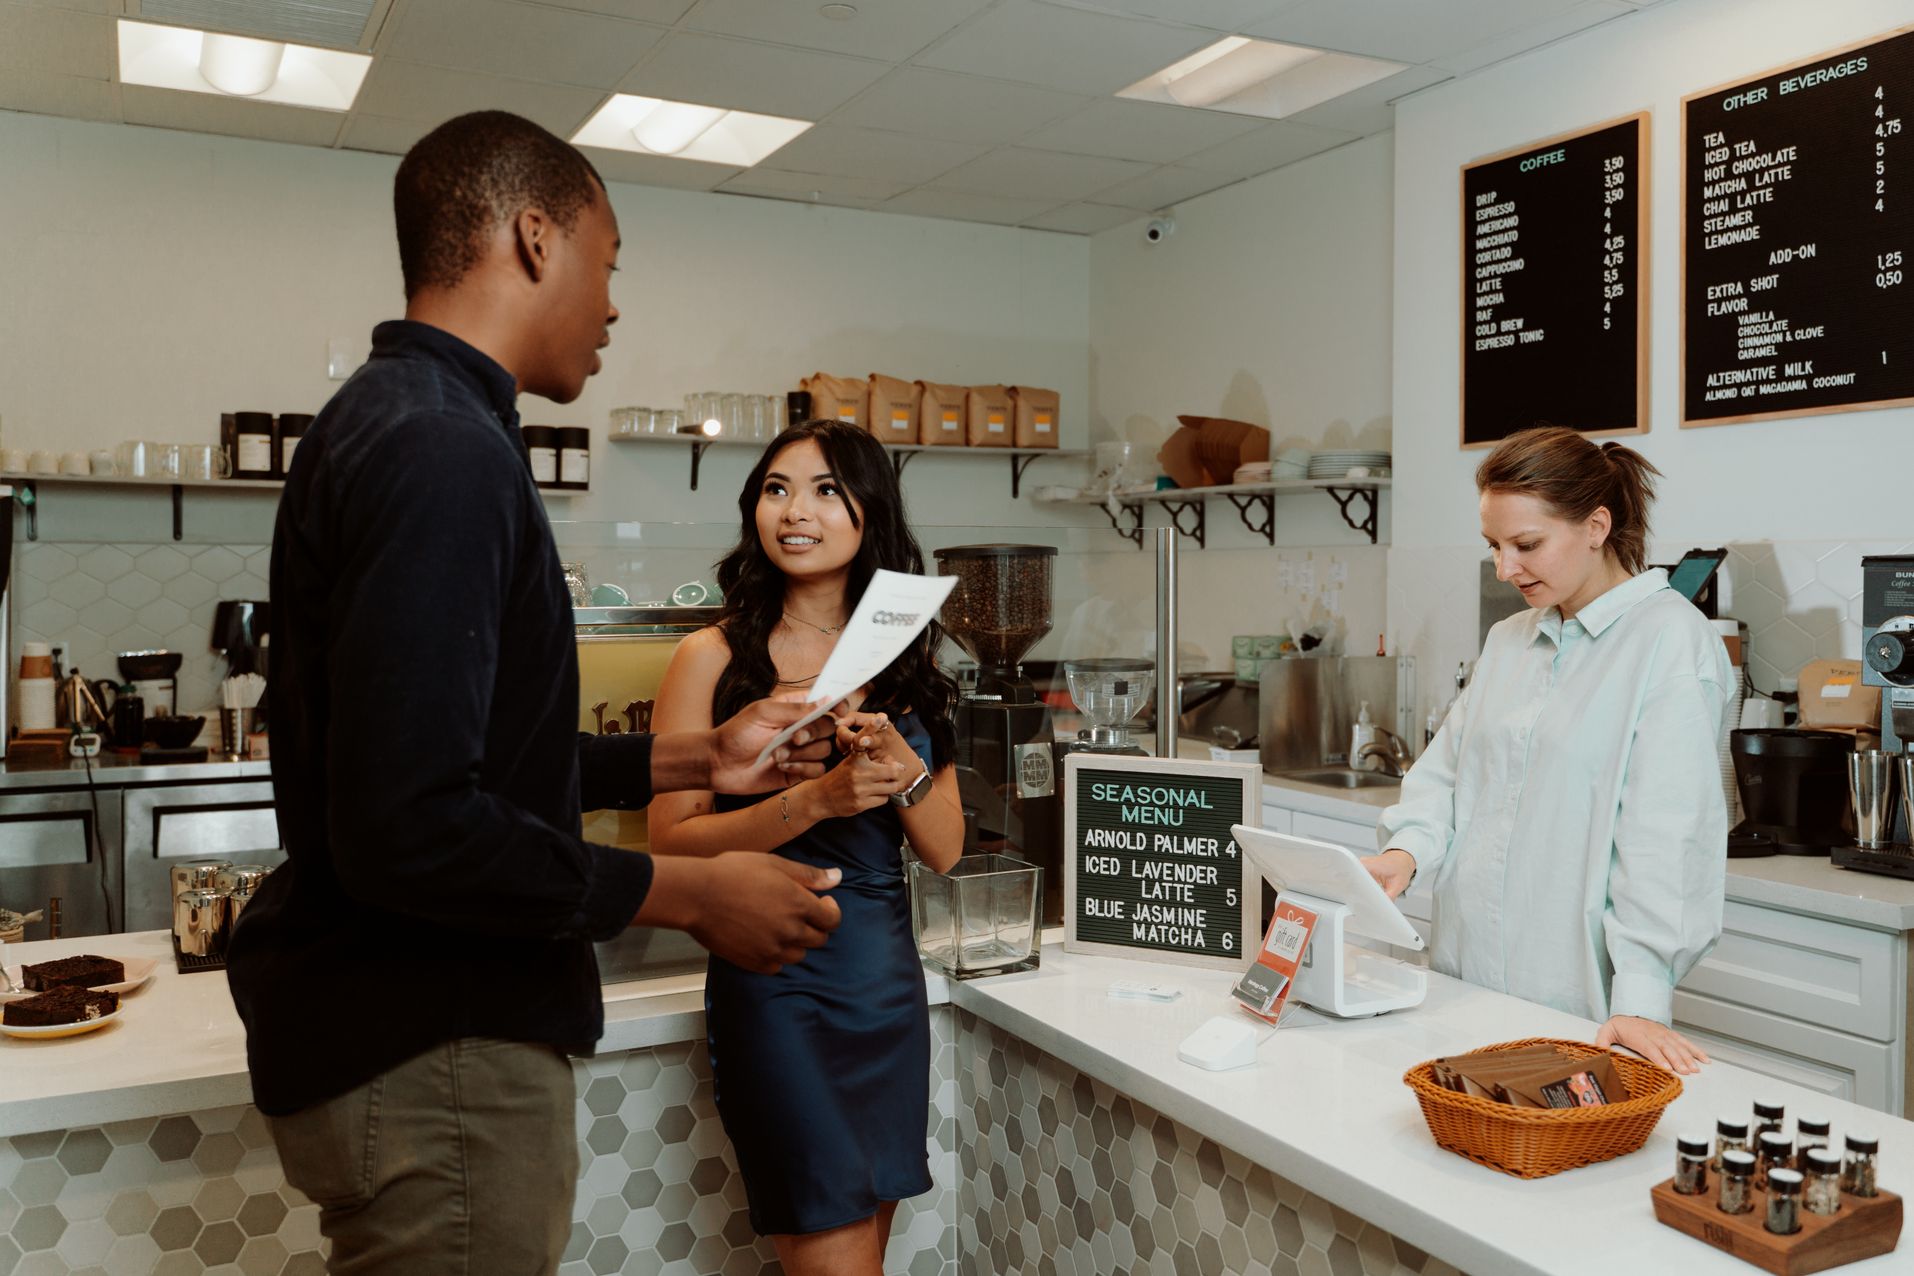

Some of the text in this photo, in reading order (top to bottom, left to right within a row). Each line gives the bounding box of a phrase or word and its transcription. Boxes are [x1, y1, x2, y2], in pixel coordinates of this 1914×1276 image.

[1723, 57, 1868, 112] OTHER BEVERAGES
[1704, 86, 1883, 148] TEA 4
[1705, 105, 1883, 165] ICED TEA 4
[1520, 149, 1566, 173] COFFEE
[1704, 164, 1726, 182] HOT
[1732, 146, 1797, 176] CHOCOLATE
[1704, 143, 1884, 199] MATCHA LATTE 5
[1476, 192, 1497, 207] DRIP
[1704, 162, 1884, 216] CHAI LATTE 5
[1476, 202, 1515, 222] ESPRESSO
[1704, 180, 1884, 234] STEAMER 2
[1476, 216, 1518, 236] AMERICANO
[1476, 207, 1611, 250] MACCHIATO 4
[1705, 199, 1884, 249] LEMONADE 4
[1476, 223, 1611, 264] CORTADO 4
[1769, 244, 1816, 266] ADD-ON
[1476, 260, 1525, 279] CAPPUCCINO
[1476, 278, 1502, 293] LATTE
[1708, 282, 1743, 300] EXTRA
[1750, 275, 1779, 293] SHOT
[1476, 293, 1504, 307] MOCHA
[1708, 298, 1748, 317] FLAVOR
[1476, 309, 1492, 322] RAF
[1476, 302, 1611, 337] COLD BREW 4
[1738, 311, 1774, 325] VANILLA
[1738, 320, 1788, 337] CHOCOLATE
[1476, 318, 1610, 351] ESPRESSO TONIC 5
[1738, 326, 1824, 348] CINNAMON & CLOVE
[1738, 345, 1778, 360] CARAMEL
[1705, 373, 1856, 401] ALMOND OAT MACADAMIA COCONUT
[1707, 366, 1776, 387] ALTERNATIVE
[1785, 361, 1813, 377] MILK
[1091, 783, 1213, 809] SEASONAL
[1121, 805, 1184, 827] MENU
[1085, 829, 1237, 858] ARNOLD PALMER 4
[1085, 855, 1218, 885] ICED LAVENDER
[1142, 880, 1237, 906] LATTE 5
[1086, 898, 1207, 928] BLUE JASMINE
[1132, 923, 1233, 950] MATCHA 6
